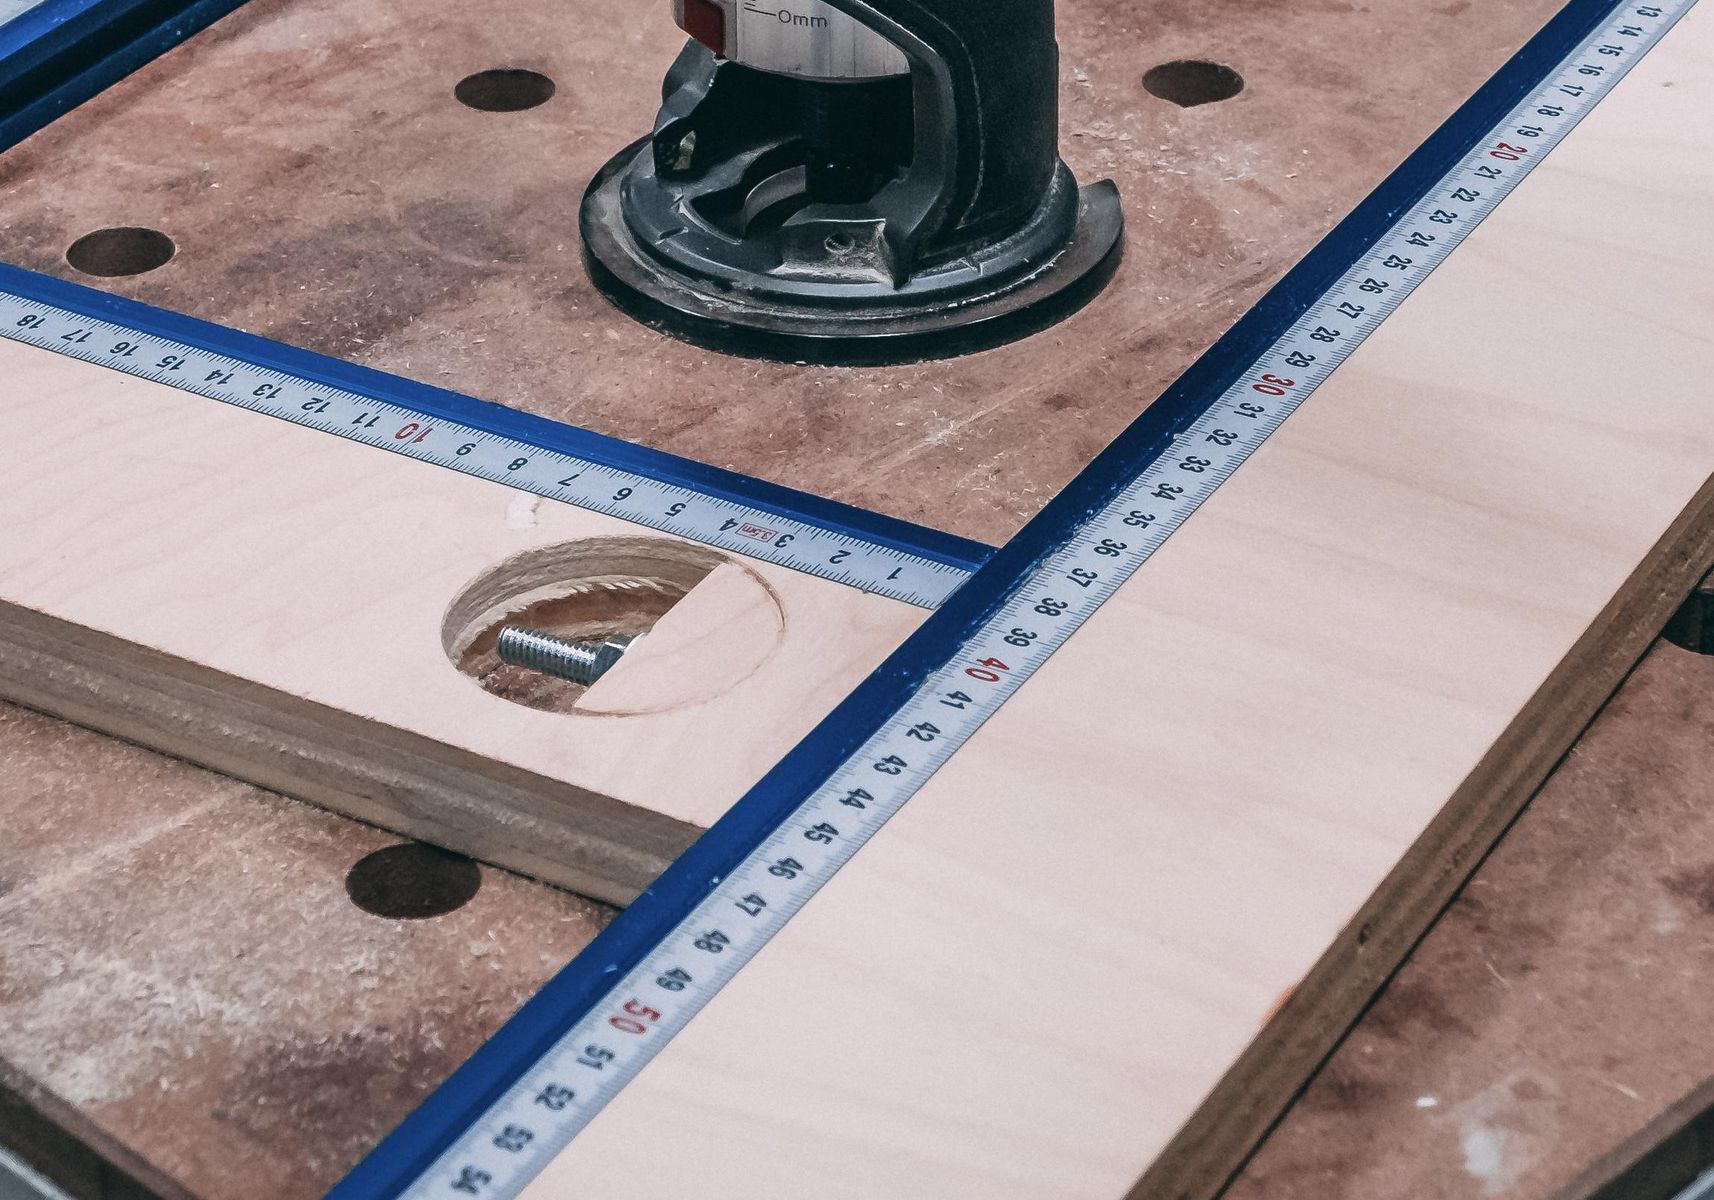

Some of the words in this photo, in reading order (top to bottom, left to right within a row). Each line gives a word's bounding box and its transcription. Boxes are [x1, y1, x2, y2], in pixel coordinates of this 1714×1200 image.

[1636, 5, 1664, 19] 13
[1616, 24, 1643, 38] 14
[1597, 43, 1625, 58] 15
[1577, 63, 1605, 78] 16
[1559, 83, 1585, 98] 17
[1536, 104, 1565, 118] 18
[1516, 124, 1544, 139] 19
[1489, 141, 1529, 162] 20
[1473, 164, 1503, 180] 21
[1450, 186, 1481, 203] 22
[1428, 208, 1459, 225] 23
[1405, 231, 1436, 248] 24
[1382, 254, 1413, 271] 25
[1358, 277, 1390, 295] 26
[1336, 301, 1366, 320] 27
[16, 313, 46, 330] 18
[60, 328, 94, 344] 17
[1309, 325, 1341, 343] 28
[108, 340, 141, 357] 16
[154, 354, 187, 372] 15
[1284, 350, 1317, 369] 29
[203, 368, 236, 386] 14
[1252, 373, 1295, 396] 30
[252, 382, 284, 400] 13
[300, 396, 332, 415] 12
[1233, 401, 1265, 419] 31
[351, 411, 382, 429] 11
[394, 422, 435, 445] 10
[1205, 428, 1239, 447] 32
[455, 442, 478, 457] 9
[506, 456, 530, 472] 8
[1178, 454, 1211, 474] 33
[557, 473, 582, 487] 7
[612, 487, 634, 502] 6
[1150, 482, 1184, 502] 34
[664, 501, 687, 518] 5
[718, 517, 739, 532] 4
[1122, 509, 1156, 530] 35
[741, 524, 773, 540] 3.5m
[774, 533, 795, 549] 3
[828, 549, 853, 565] 2
[1093, 538, 1128, 558] 36
[885, 566, 906, 581] 1
[1066, 567, 1098, 589] 37
[1033, 596, 1069, 618] 38
[1003, 627, 1038, 648] 39
[964, 656, 1010, 683] 40
[939, 689, 973, 710] 41
[905, 720, 942, 743] 42
[872, 753, 909, 777] 43
[838, 787, 875, 811] 44
[803, 821, 840, 846] 45
[767, 856, 805, 881] 46
[734, 892, 767, 918] 47
[693, 928, 731, 955] 48
[655, 966, 693, 993] 49
[607, 998, 662, 1036] 50
[575, 1043, 616, 1072] 51
[533, 1081, 577, 1112] 52
[491, 1122, 536, 1154] 53
[450, 1164, 493, 1196] 54
